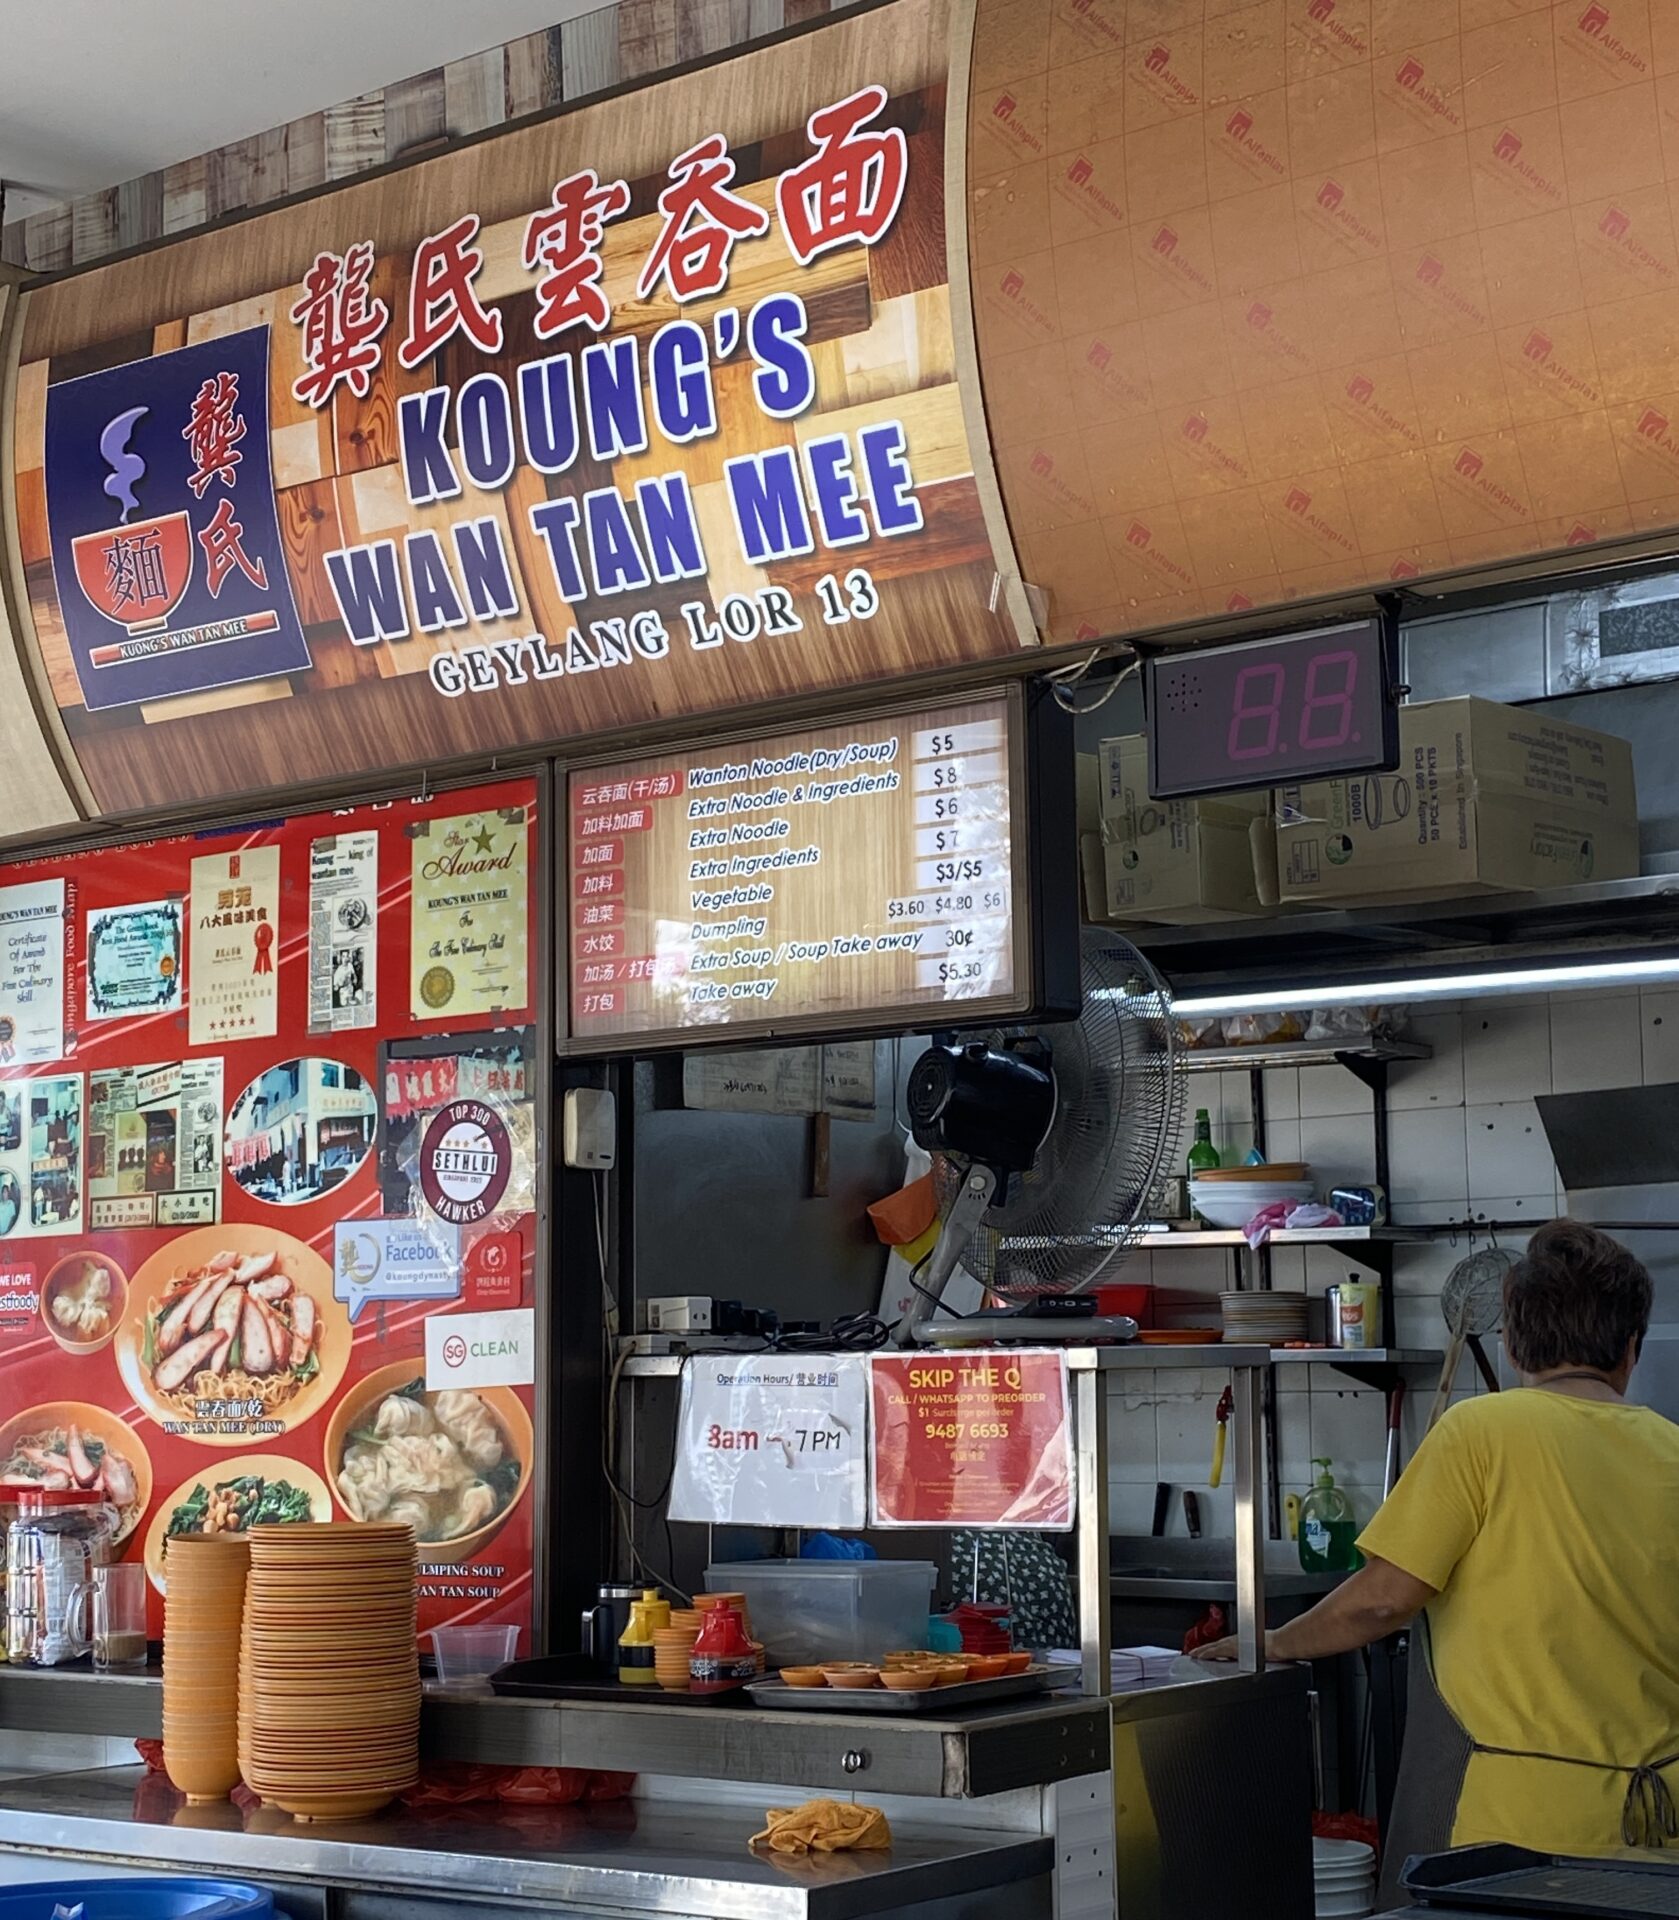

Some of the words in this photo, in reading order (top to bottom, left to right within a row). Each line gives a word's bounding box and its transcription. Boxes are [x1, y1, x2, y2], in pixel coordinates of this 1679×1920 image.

[1600, 33, 1648, 73] Alfaplas
[1415, 86, 1460, 126] Alfaplas
[401, 295, 813, 503] KOUNG'S
[1478, 477, 1528, 516] Alfaplas
[325, 517, 519, 646] WAN
[532, 471, 708, 602] TAN
[727, 421, 924, 564] MEE
[171, 630, 197, 648] WAN
[199, 625, 221, 642] TAN
[222, 619, 248, 637] MEE
[431, 610, 665, 696] GEYLANG
[688, 586, 801, 648] LOR
[816, 569, 879, 625] 13
[689, 764, 747, 787] Wanton
[751, 739, 898, 772] Noodle(Dry/Soup)
[1414, 747, 1424, 770] PCS
[1427, 747, 1437, 776] PKTS
[689, 798, 726, 817] Extra
[731, 786, 788, 810] Noodle
[792, 788, 803, 802] &
[808, 773, 899, 802] Ingredients
[1351, 784, 1361, 822] 1000B
[582, 810, 643, 835] 加料加面
[690, 829, 727, 848] Extra
[731, 820, 789, 842] Noodle
[1418, 800, 1428, 845] Quantity
[423, 842, 517, 880] Award
[582, 844, 614, 865] 加面
[690, 860, 727, 879] Extra
[731, 848, 819, 876] Ingredients
[935, 860, 982, 883] $3/$5
[461, 894, 476, 904] WAN
[478, 892, 491, 901] TAN
[492, 889, 508, 899] MEE
[582, 876, 614, 894] 加料
[691, 886, 772, 910] Vegetable
[888, 901, 924, 918] $3.60
[935, 896, 973, 914] $4.80
[583, 905, 614, 924] 油菜
[691, 918, 766, 941] Dumpling
[583, 934, 614, 953] 水饺
[690, 953, 727, 971] Extra
[733, 948, 771, 967] Soup
[788, 944, 828, 962] Soup
[833, 938, 871, 955] Take
[876, 931, 923, 951] away
[938, 961, 981, 983] $5.30
[690, 984, 727, 1001] Take
[731, 978, 777, 999] away
[583, 994, 614, 1013] 打包
[449, 1105, 469, 1122] TOP
[471, 1105, 490, 1125] 300
[435, 1152, 496, 1172] SETHLUI
[435, 1195, 486, 1221] HAWKER
[11, 1273, 31, 1286] LOVE
[446, 1343, 464, 1359] SG
[471, 1340, 519, 1357] CLEAN
[764, 1374, 793, 1384] Hours/
[909, 1370, 954, 1388] SKIP
[959, 1368, 1000, 1387] THE
[1005, 1368, 1021, 1390] Q
[888, 1395, 911, 1404] CALL
[919, 1394, 973, 1403] WHATSAPP
[976, 1394, 989, 1402] TO
[993, 1393, 1046, 1402] PREORDER
[919, 1407, 929, 1418] $1
[163, 1421, 190, 1433] WAN
[192, 1421, 217, 1433] TAN
[220, 1421, 247, 1433] MEE
[249, 1420, 286, 1434] (DRY)
[926, 1424, 966, 1439] 9487
[970, 1423, 1009, 1438] 6693
[471, 1565, 505, 1577] SOUP
[420, 1585, 436, 1596] AN
[439, 1586, 464, 1597] TAN
[468, 1586, 500, 1598] SOUP
